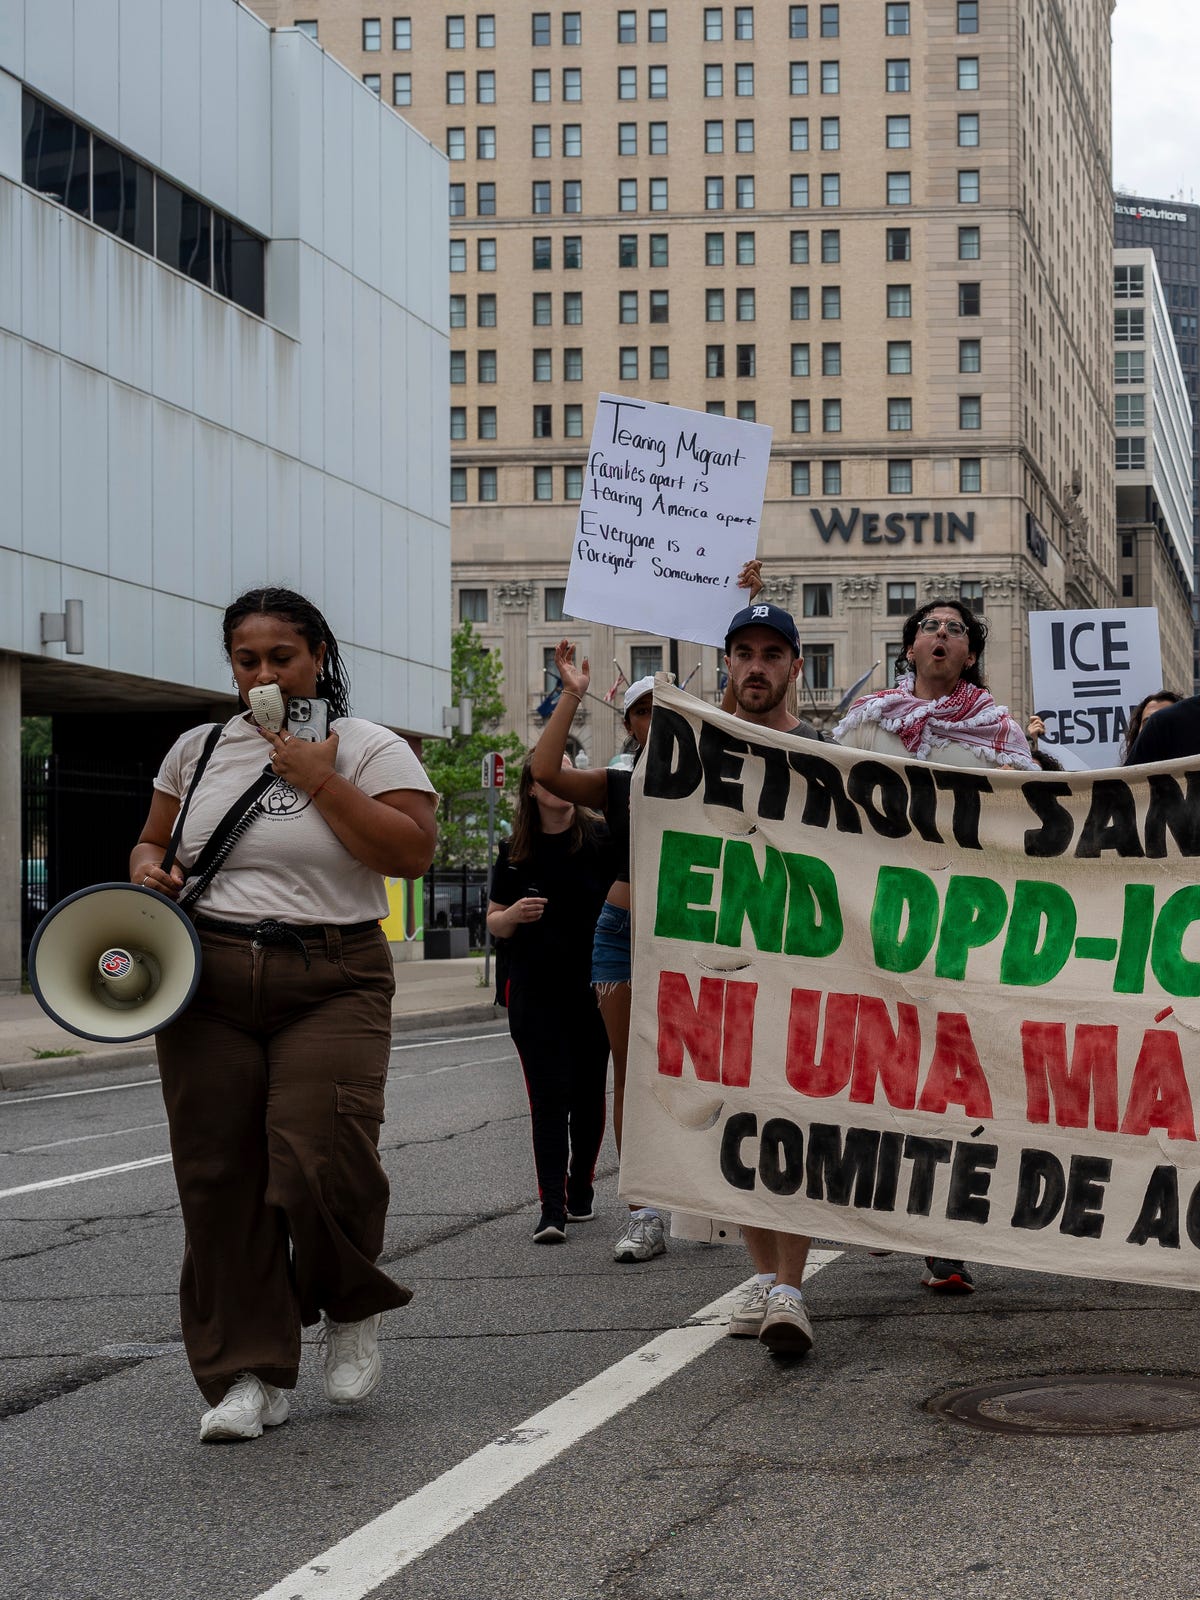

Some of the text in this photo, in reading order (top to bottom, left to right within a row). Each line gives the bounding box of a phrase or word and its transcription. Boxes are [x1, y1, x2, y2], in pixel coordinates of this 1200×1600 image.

[1138, 206, 1187, 222] Solutions
[600, 400, 746, 476] Tearing Migrant
[588, 452, 709, 493] families apart is
[590, 479, 758, 527] tearing America apart
[809, 507, 976, 545] WESTIN
[580, 510, 656, 550] Everyone
[696, 545, 706, 557] a
[577, 540, 730, 589] foreigner Somewhere!
[751, 605, 770, 619] D
[1051, 621, 1131, 672] ICE
[1036, 703, 1138, 746] GESTA
[643, 704, 994, 851] DETROIT
[654, 830, 844, 958] END
[657, 970, 758, 1088] NI
[785, 988, 994, 1119] UNA
[719, 1111, 999, 1225] COMITÉ
[1010, 1148, 1113, 1240] DE
